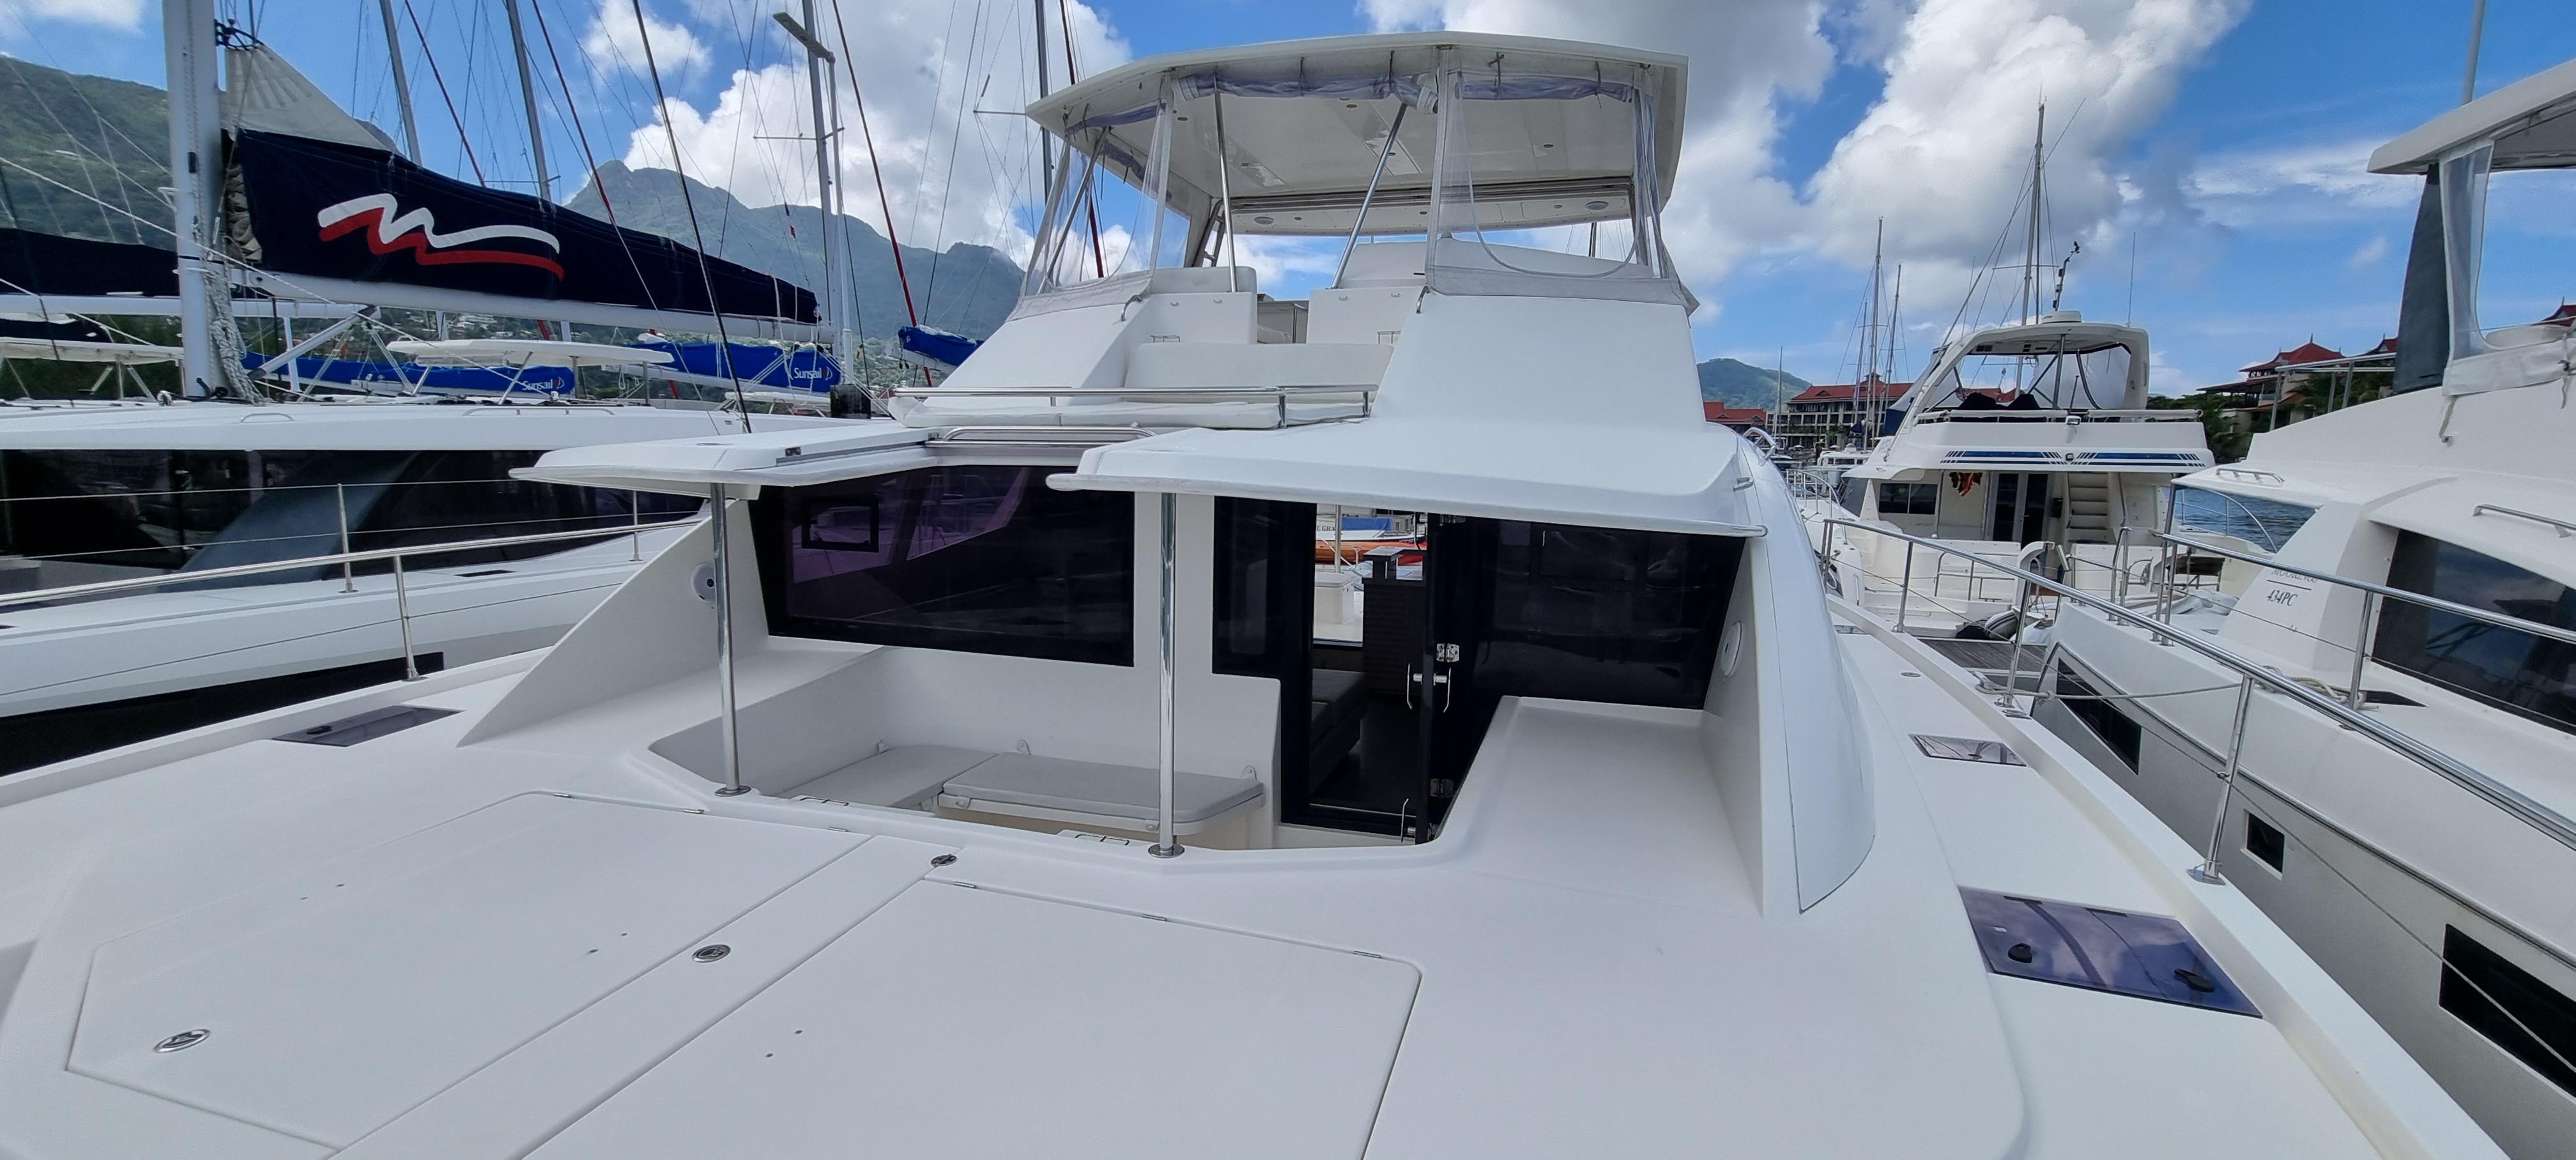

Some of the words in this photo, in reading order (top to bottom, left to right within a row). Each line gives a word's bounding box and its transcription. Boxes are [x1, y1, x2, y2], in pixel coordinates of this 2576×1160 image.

[794, 367, 822, 379] Sunsail
[522, 379, 553, 390] Sunsail
[2267, 589, 2298, 606] 434PC
